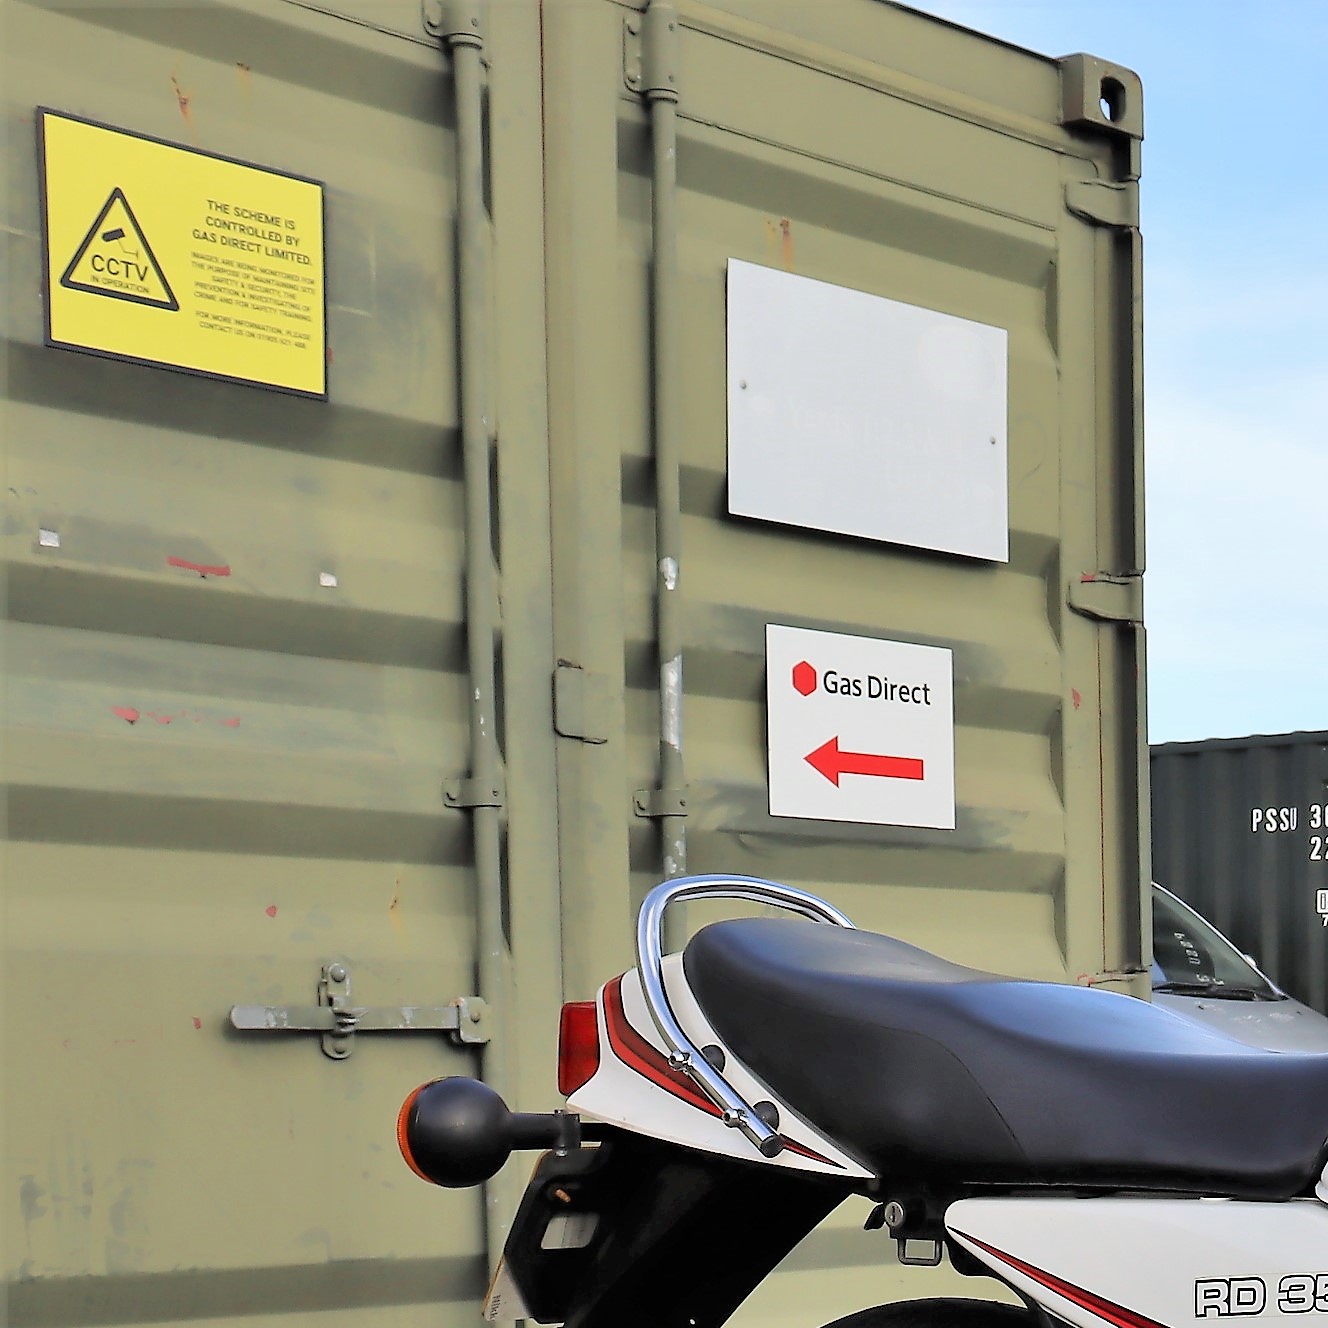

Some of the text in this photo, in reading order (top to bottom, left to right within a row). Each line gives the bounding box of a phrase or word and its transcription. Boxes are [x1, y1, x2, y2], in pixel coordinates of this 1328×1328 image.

[207, 200, 295, 230] THE SCHEME IS
[193, 229, 216, 243] GAS
[221, 236, 261, 253] DIRECT
[206, 216, 300, 246] CONTROLLED BY
[91, 254, 148, 282] CCTV
[823, 671, 931, 705] Gas Direct
[1251, 807, 1298, 832] PSSU
[1194, 1276, 1267, 1319] RD
